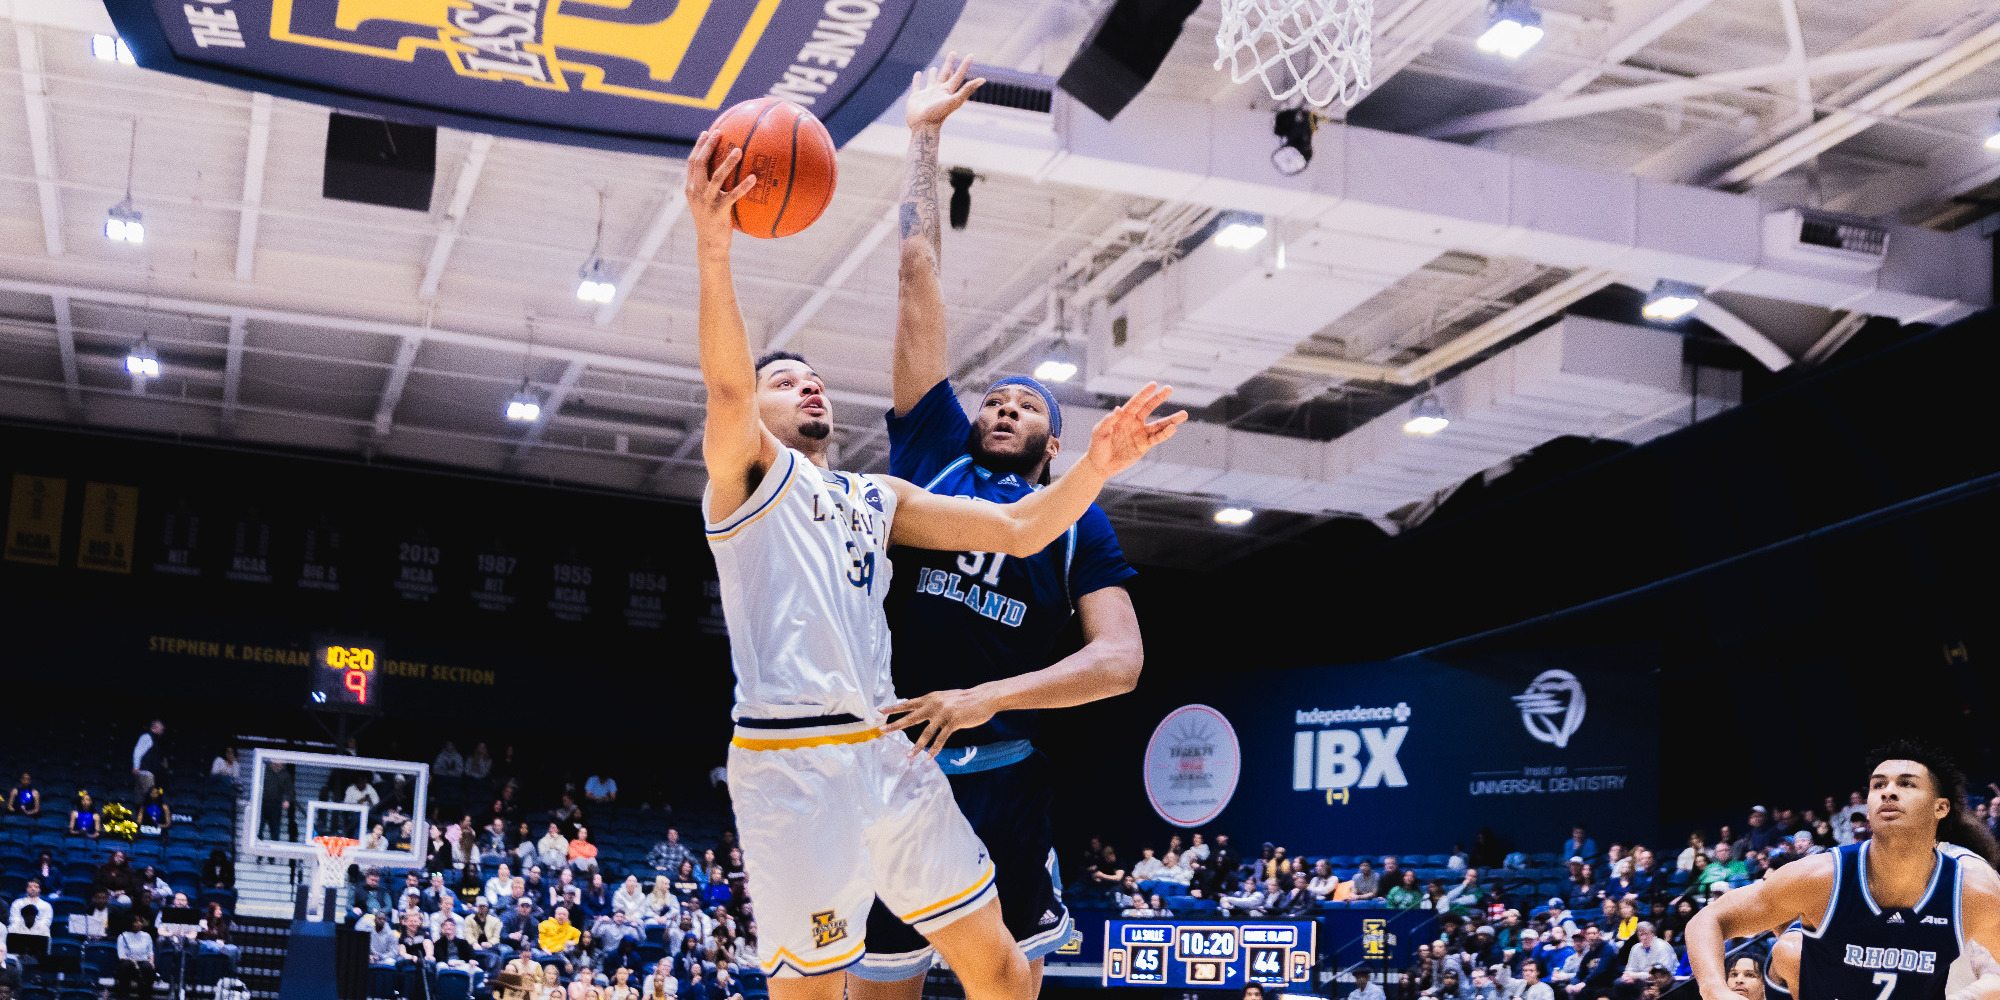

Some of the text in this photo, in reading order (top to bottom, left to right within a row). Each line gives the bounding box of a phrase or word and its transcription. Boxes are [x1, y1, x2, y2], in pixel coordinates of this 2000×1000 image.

[184, 4, 246, 48] THE
[797, 0, 884, 69] OYNE
[399, 542, 440, 565] 2013
[478, 554, 517, 575] 1987
[553, 563, 592, 585] 1955
[628, 571, 667, 593] 1954
[917, 567, 1028, 628] ISLAND
[149, 635, 219, 659] STEPHEN
[243, 646, 310, 667] DEGNAN
[383, 659, 427, 679] DENT
[431, 664, 495, 685] SECTION
[327, 646, 374, 671] 10:20
[345, 669, 367, 704] 9
[1295, 705, 1393, 727] Independence
[1293, 725, 1409, 791] IBX
[1469, 775, 1627, 796] UNIVERSAL DENTISTRY
[1180, 932, 1234, 955] 10:20
[1135, 949, 1159, 971] 45
[1254, 951, 1280, 973] 44
[1844, 943, 1937, 974] RHODE
[1872, 971, 1898, 1000] 7
